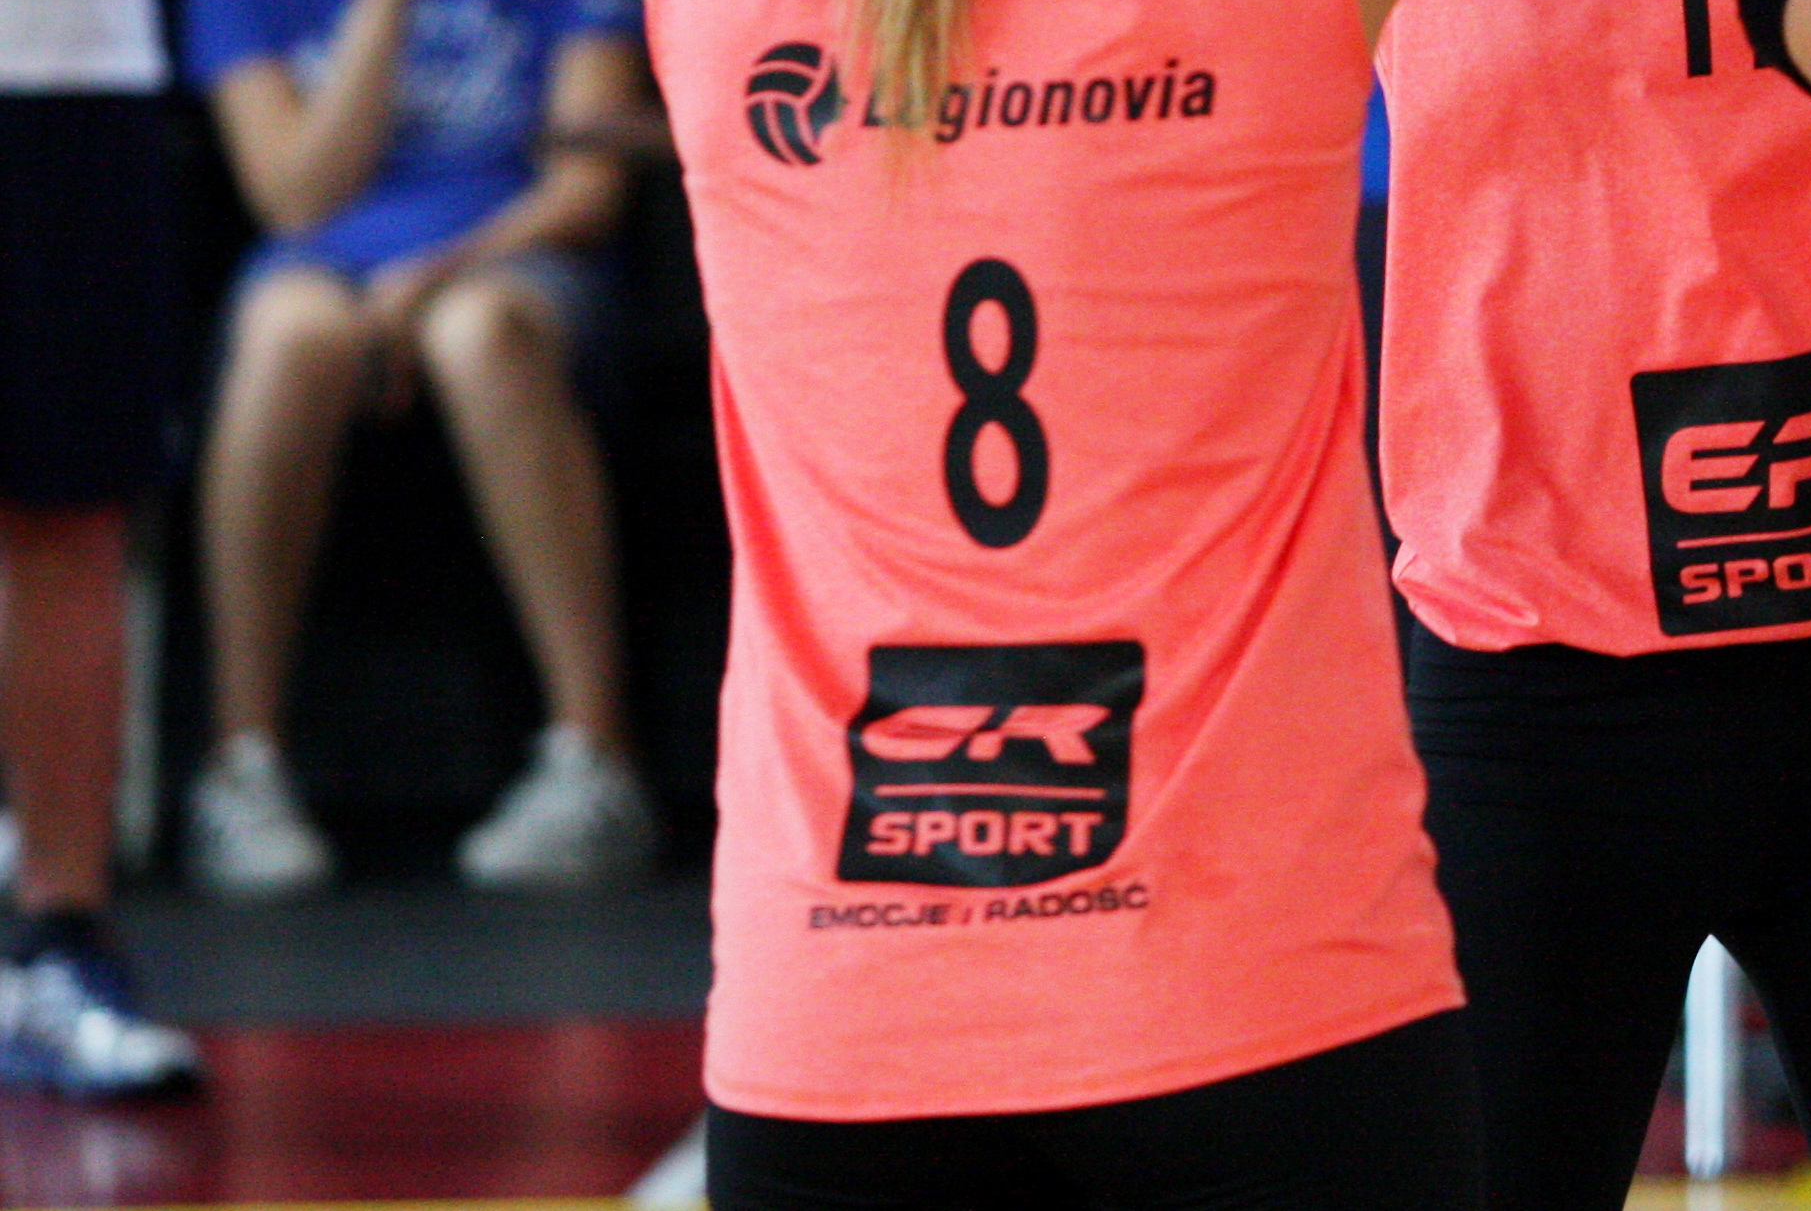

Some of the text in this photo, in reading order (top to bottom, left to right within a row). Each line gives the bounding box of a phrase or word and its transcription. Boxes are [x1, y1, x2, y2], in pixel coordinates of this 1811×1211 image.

[944, 257, 1050, 548] 8
[865, 809, 1105, 856] SPORT
[810, 903, 949, 928] EMOCJE
